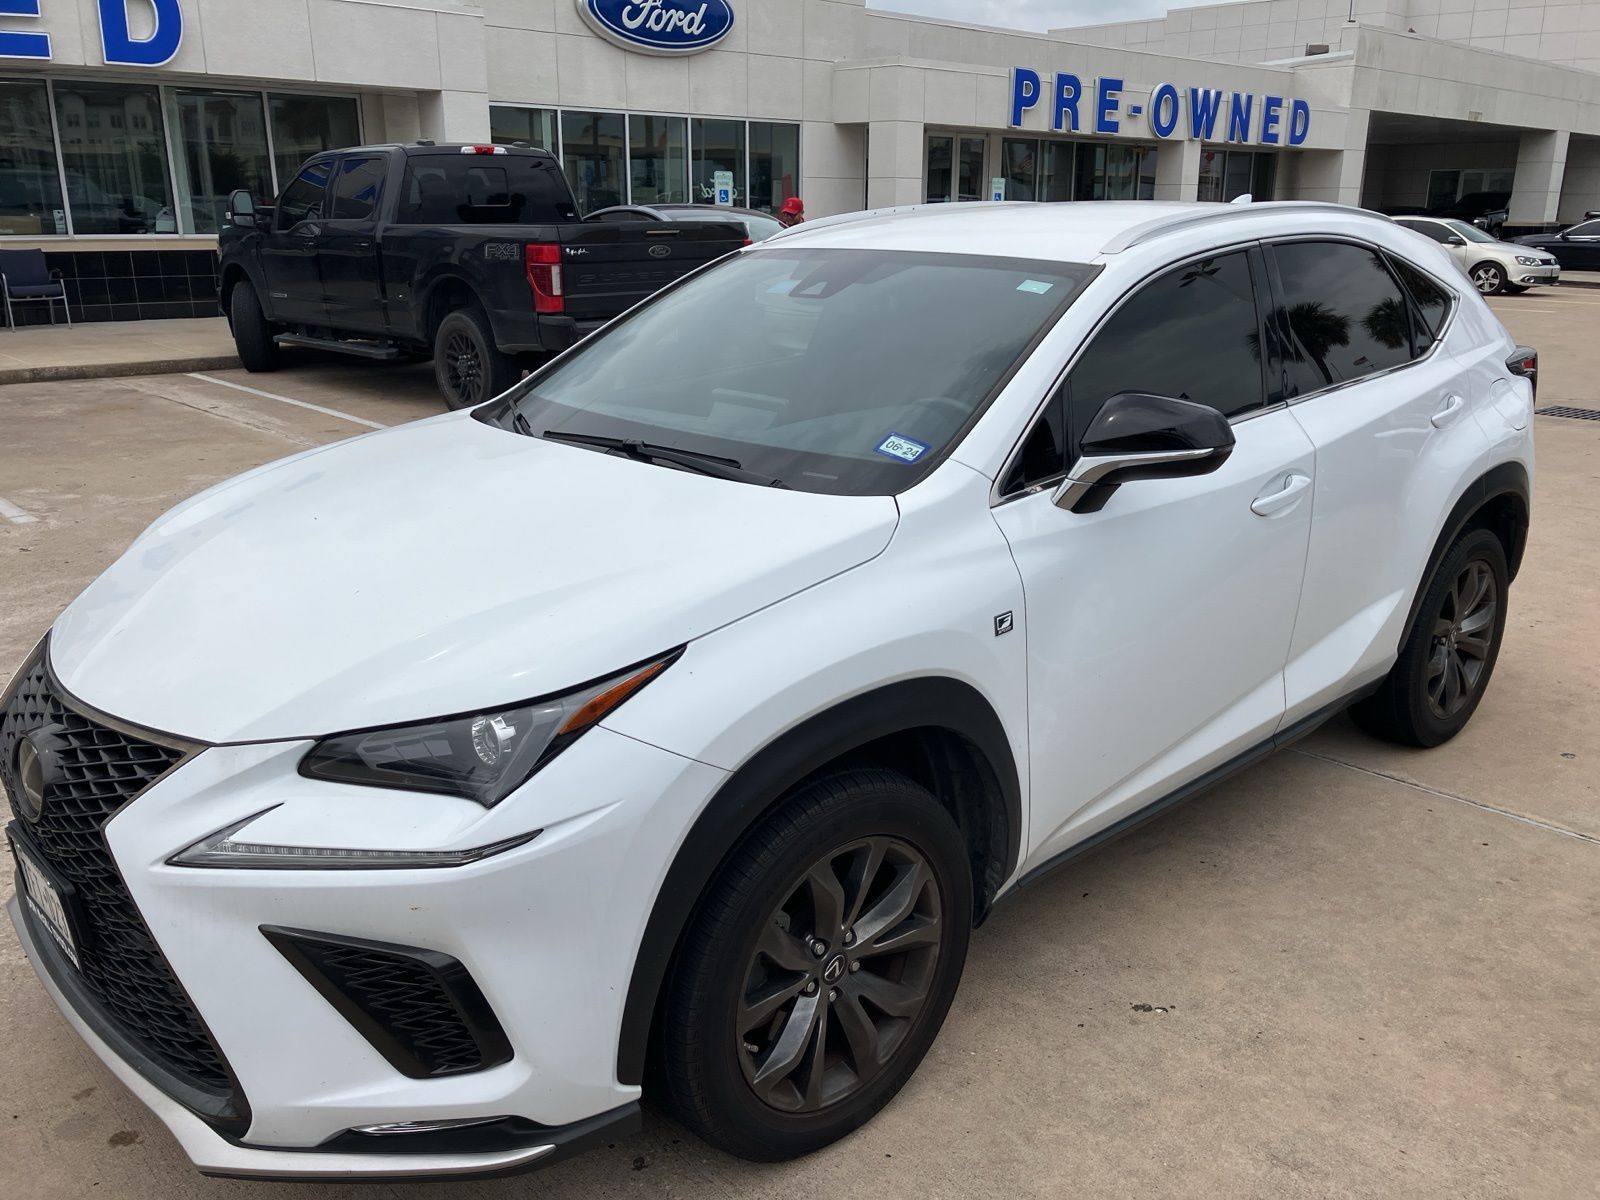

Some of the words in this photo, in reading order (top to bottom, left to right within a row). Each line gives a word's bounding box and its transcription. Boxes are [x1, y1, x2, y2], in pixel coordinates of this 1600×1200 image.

[621, 0, 708, 35] Ford
[1008, 66, 1311, 147] PRE-OWNED
[484, 243, 520, 258] FX4
